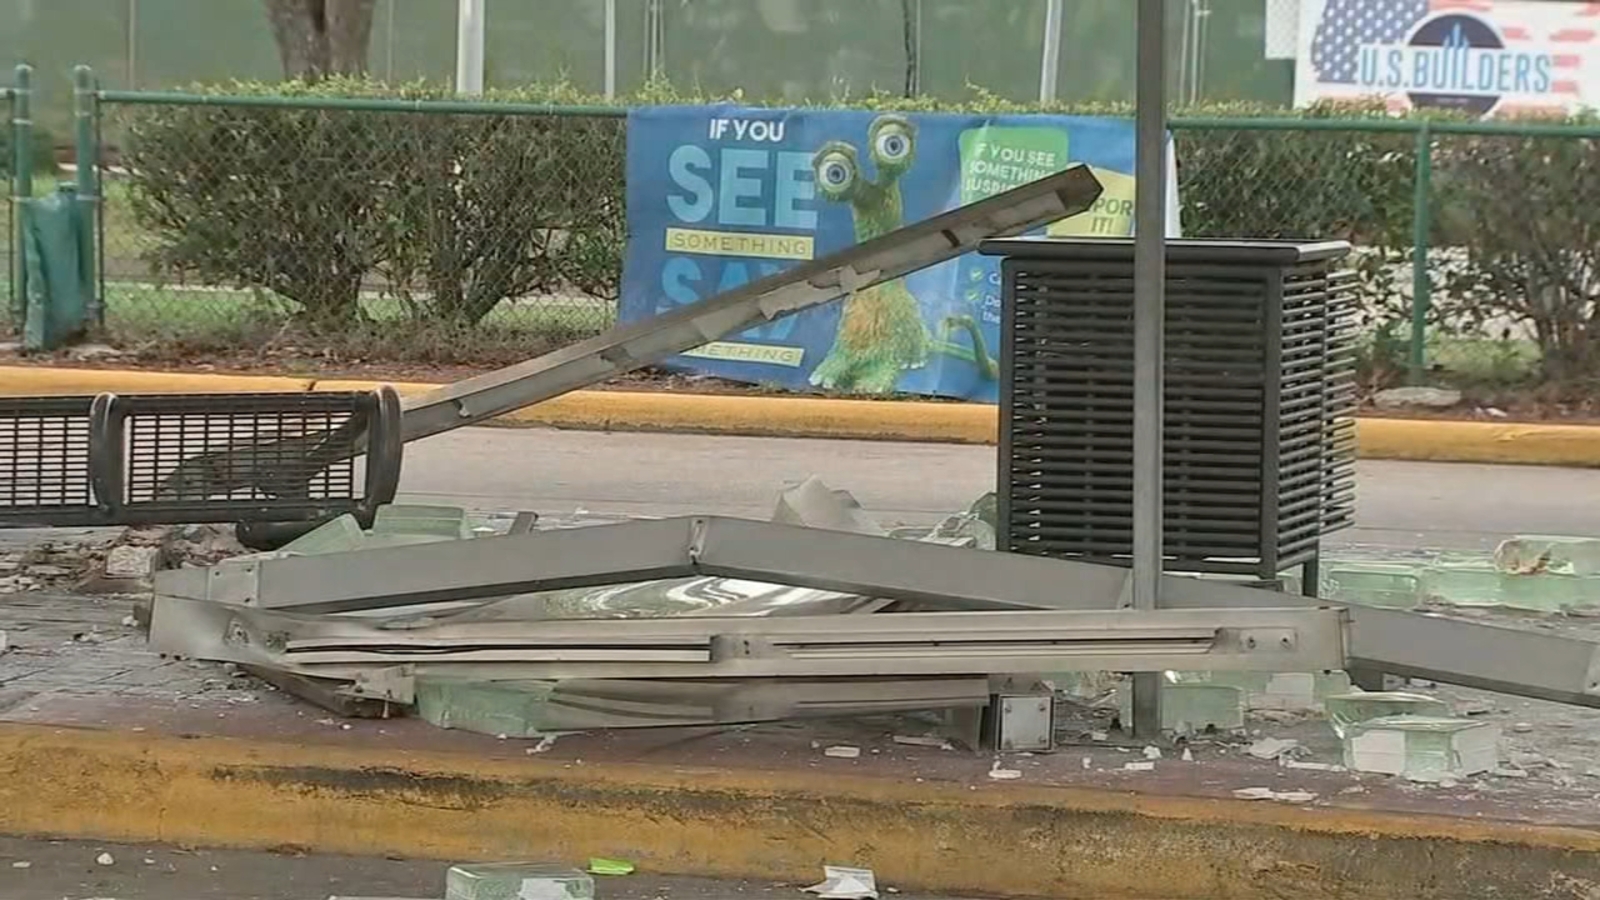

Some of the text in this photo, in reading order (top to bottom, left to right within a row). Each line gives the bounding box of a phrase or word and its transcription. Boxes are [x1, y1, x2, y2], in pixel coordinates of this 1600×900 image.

[709, 118, 785, 142] IF YOU
[990, 144, 1026, 163] YOU
[1027, 149, 1056, 168] SEE
[666, 144, 818, 230] SEE
[1093, 197, 1134, 216] POR
[1090, 216, 1115, 235] IT!
[673, 231, 807, 256] SOMETHING
